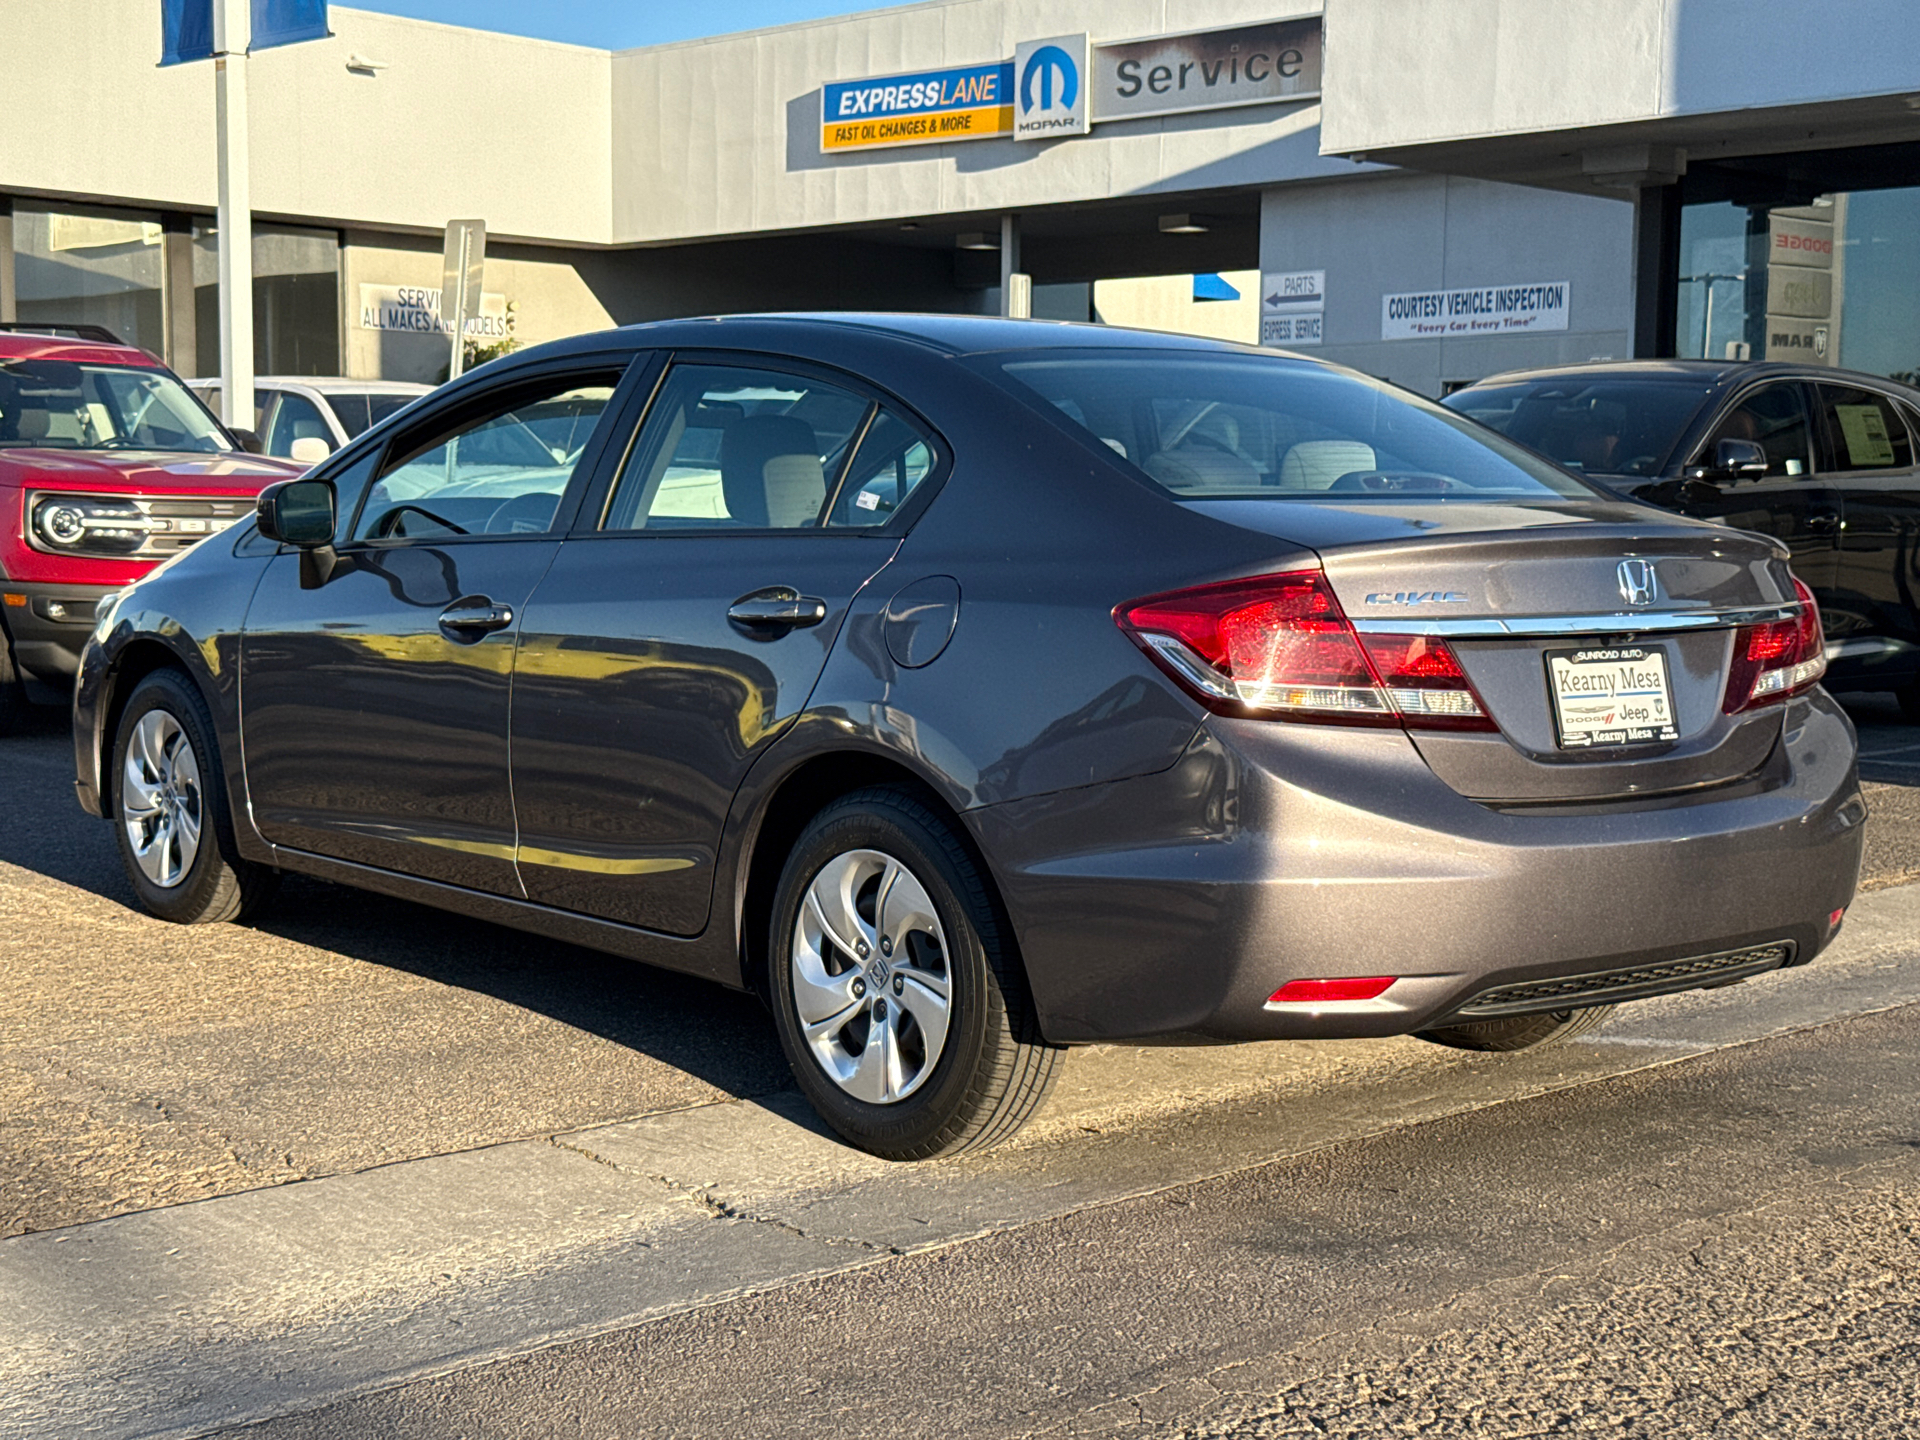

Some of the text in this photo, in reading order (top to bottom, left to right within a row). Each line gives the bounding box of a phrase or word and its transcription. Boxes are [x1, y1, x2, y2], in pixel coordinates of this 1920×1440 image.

[1116, 43, 1303, 98] Service
[835, 115, 972, 142] FAST OIL CHANGES & MORE
[1019, 117, 1075, 132] MOPAR
[1284, 275, 1315, 294] PARTS
[398, 288, 442, 309] SERVI
[1389, 285, 1563, 319] COURTESY VEHICLE INSPECTION
[364, 307, 386, 328] ALL
[388, 308, 430, 331] MAKES
[1264, 318, 1320, 340] EXPRESS SERVICE
[1450, 321, 1467, 331] Car
[1471, 319, 1500, 331] Every
[1365, 591, 1468, 606] CIVIC
[1577, 649, 1642, 661] SUNROAD AUTO
[1558, 667, 1662, 698] Kearny Mesa
[1619, 704, 1649, 722] Jeep
[1591, 730, 1626, 744] Kearny
[1627, 727, 1653, 739] Mesa
